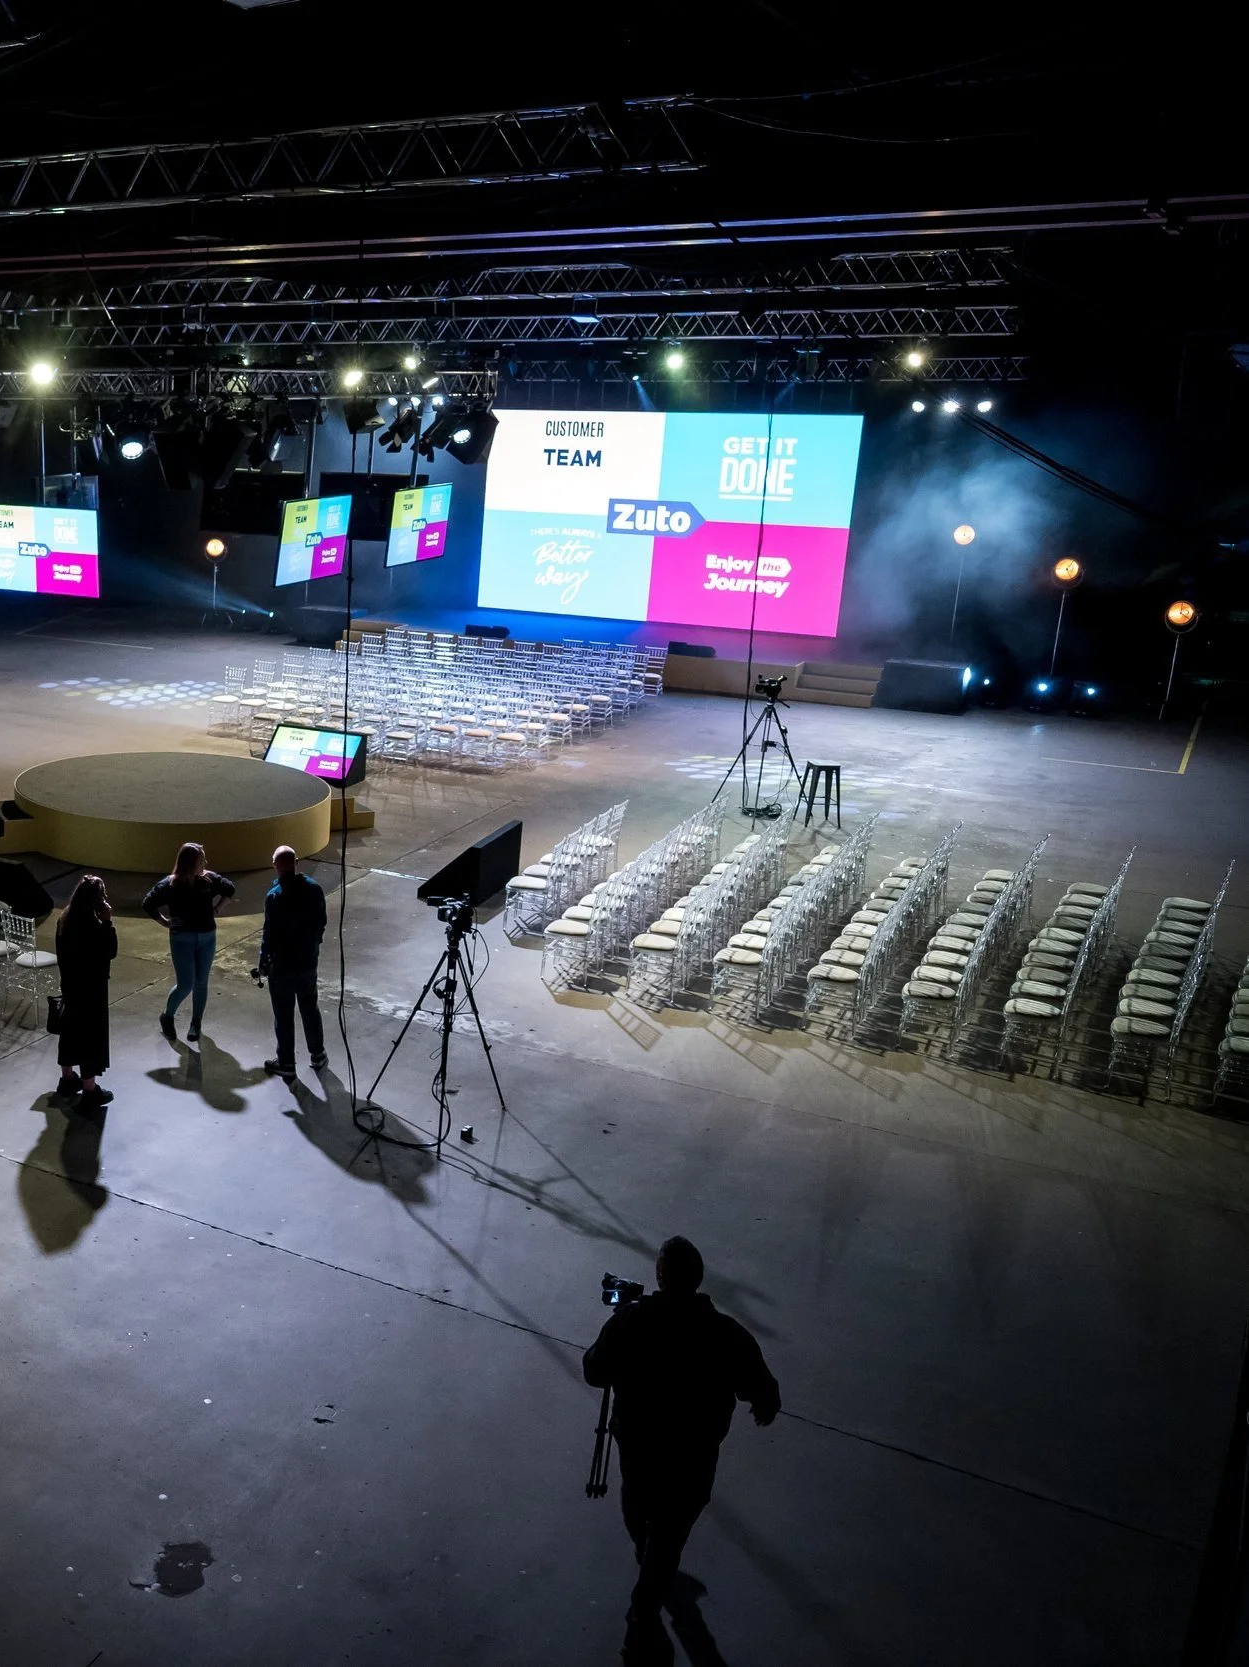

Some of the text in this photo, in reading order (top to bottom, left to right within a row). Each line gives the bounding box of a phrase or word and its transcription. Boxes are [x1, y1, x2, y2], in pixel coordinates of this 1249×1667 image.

[545, 420, 604, 438] CUSTOMER
[723, 436, 799, 456] GET IT
[543, 448, 602, 467] TEAM
[719, 456, 797, 495] DONE
[612, 503, 691, 533] Zuto
[19, 543, 48, 557] Zuto
[532, 540, 595, 566] Better
[705, 553, 755, 575] Enjoy
[703, 572, 790, 599] Journey
